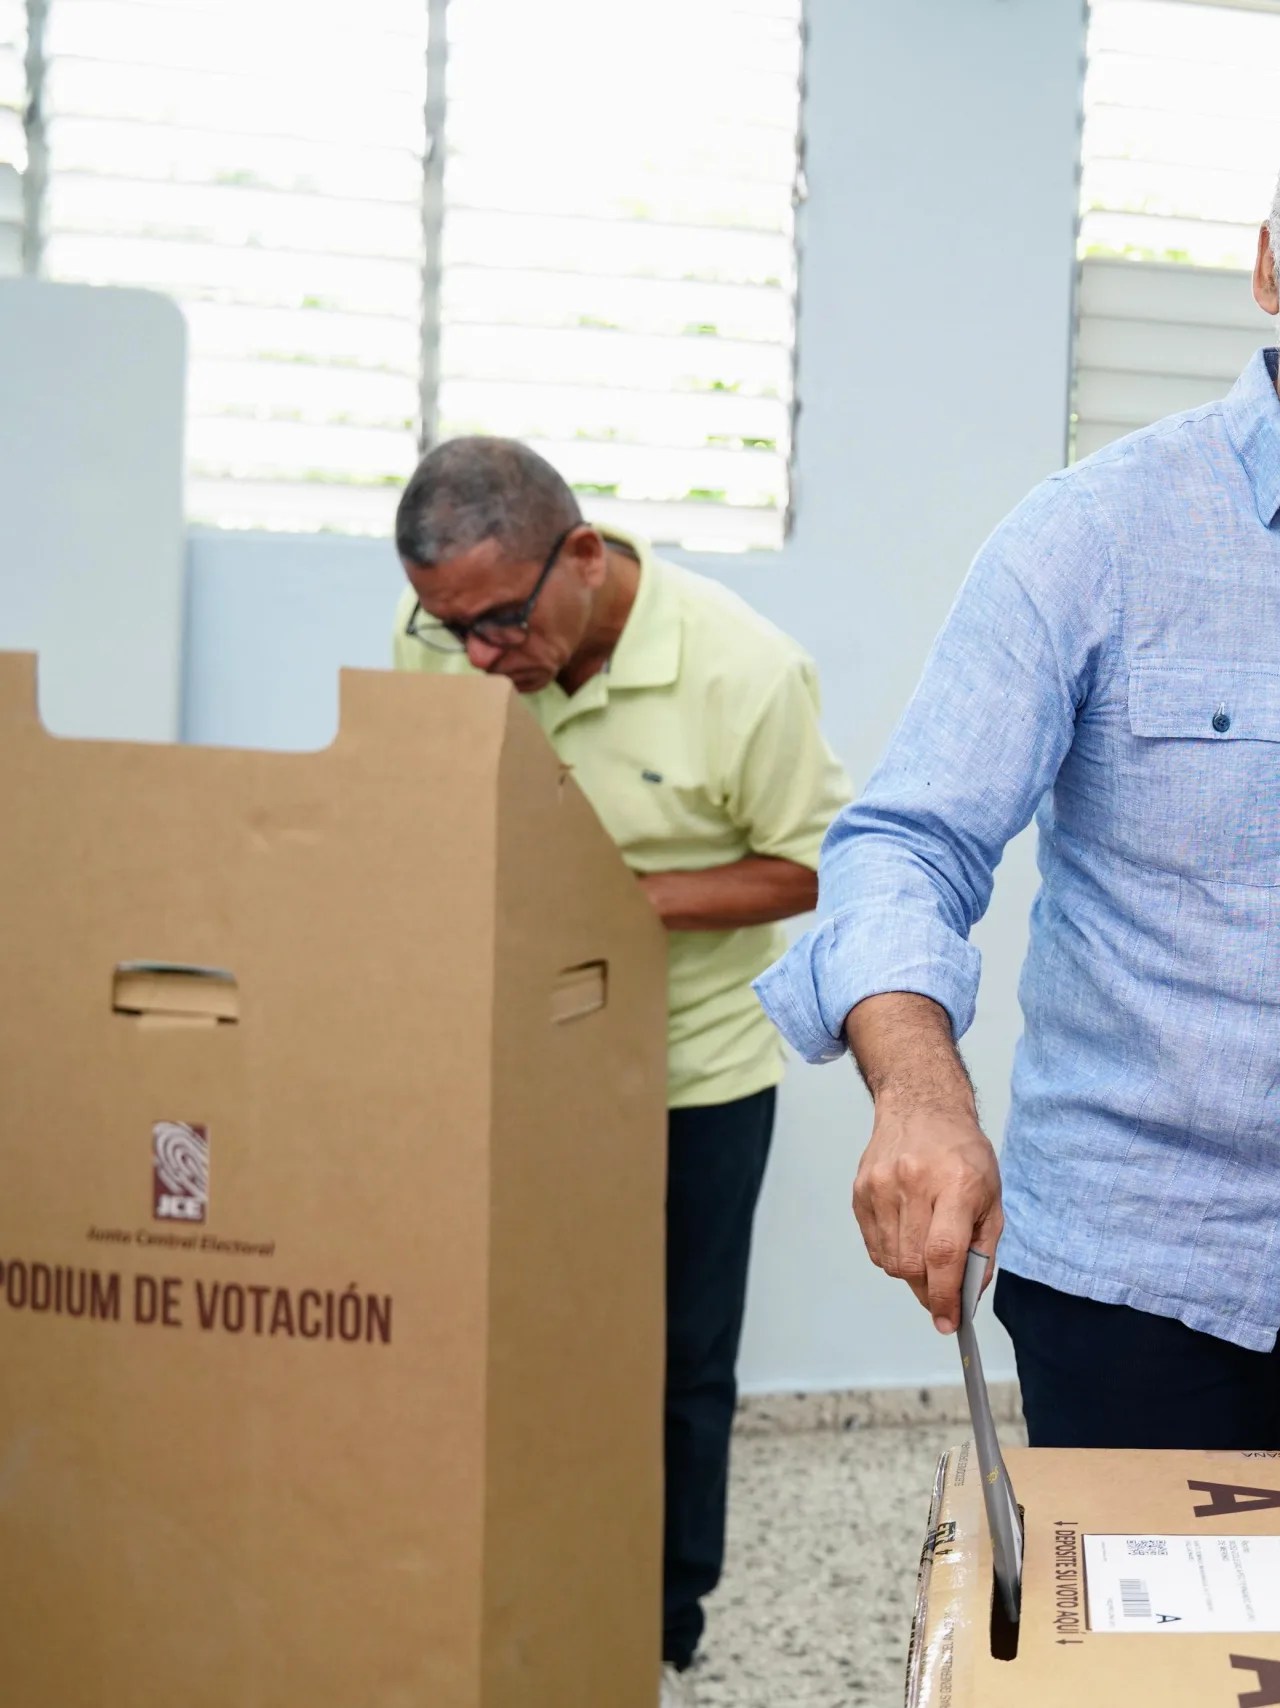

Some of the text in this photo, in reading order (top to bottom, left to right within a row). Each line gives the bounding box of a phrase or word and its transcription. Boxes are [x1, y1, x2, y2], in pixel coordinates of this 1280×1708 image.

[157, 1196, 203, 1218] JCE
[134, 1229, 198, 1251] Central
[199, 1234, 276, 1257] Electoral
[134, 1273, 183, 1328] DE
[195, 1281, 393, 1345] VOTACIÓN
[1052, 1529, 1087, 1635] DEPOSITE SU VOTO AQUÍ
[1156, 1613, 1182, 1624] A
